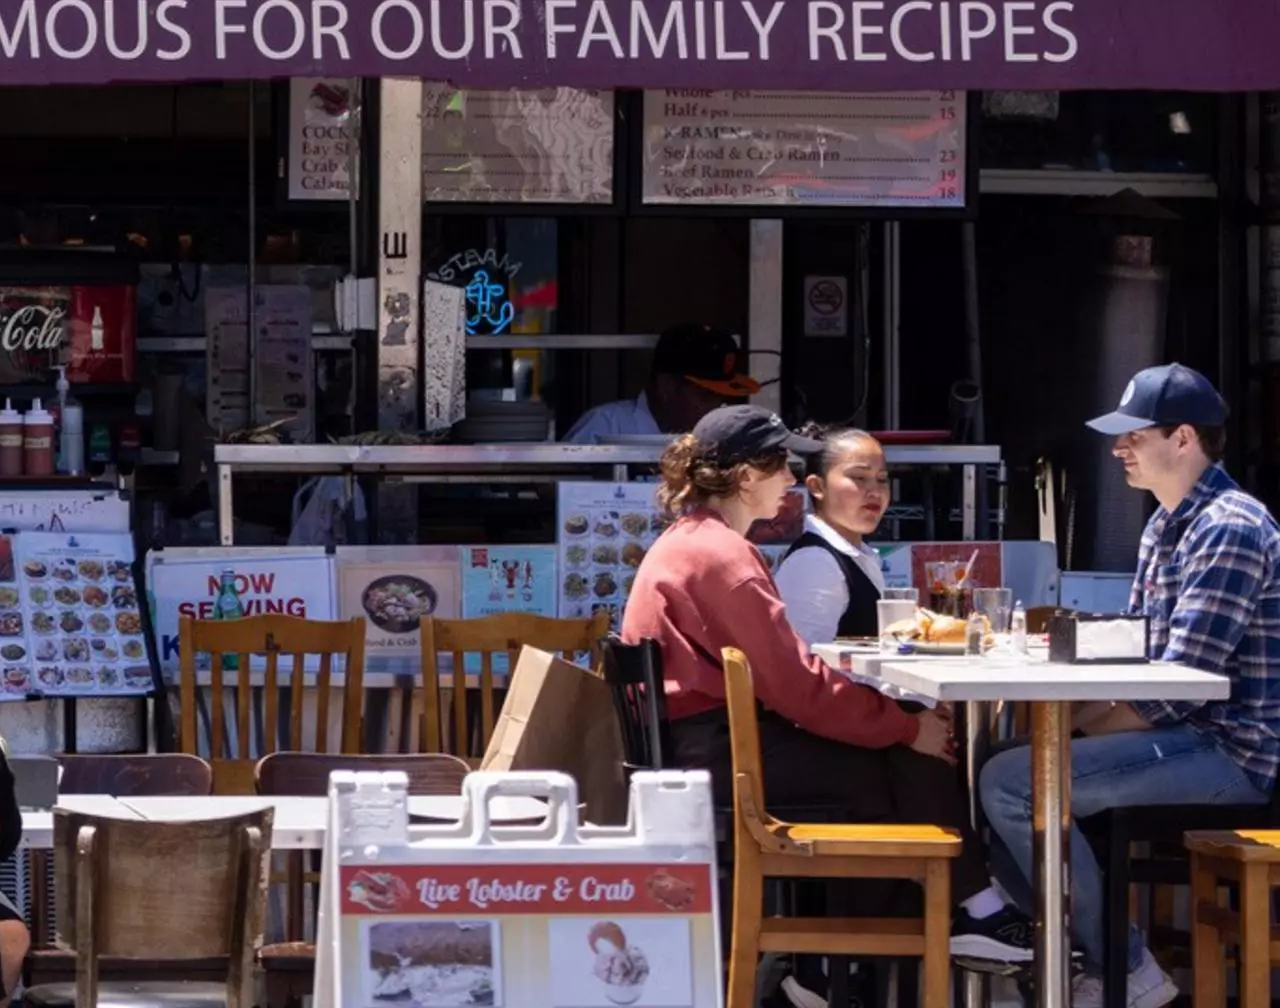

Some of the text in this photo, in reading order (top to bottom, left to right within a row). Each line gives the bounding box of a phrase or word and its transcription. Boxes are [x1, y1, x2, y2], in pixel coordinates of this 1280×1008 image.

[544, 0, 785, 62] FAMILY
[808, 0, 1078, 63] RECIPES
[664, 103, 699, 118] Half
[940, 107, 955, 120] 15
[940, 149, 955, 162] 23
[701, 166, 755, 180] Ramen
[940, 168, 955, 181] 19
[207, 572, 276, 597] NOW
[178, 597, 307, 620] SEVING
[416, 875, 636, 909] Live Lobster & Crab
